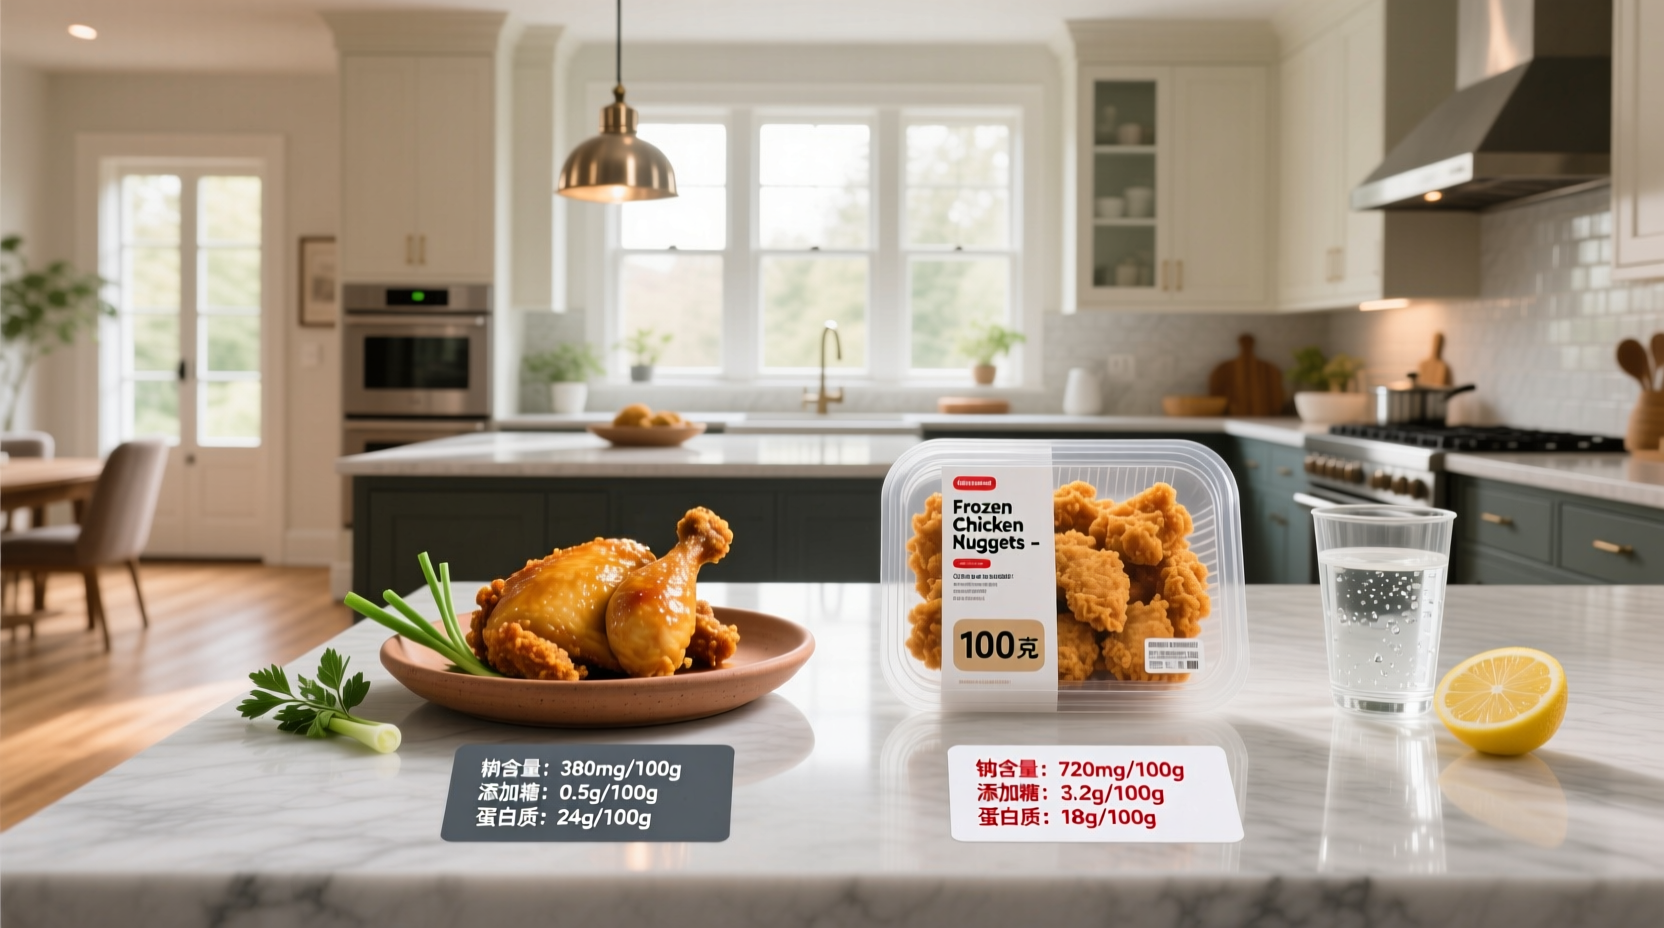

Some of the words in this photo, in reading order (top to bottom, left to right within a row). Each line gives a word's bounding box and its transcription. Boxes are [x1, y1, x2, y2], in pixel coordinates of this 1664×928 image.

[953, 499, 1013, 515] Frozen
[953, 516, 1024, 533] Chicken
[953, 534, 1025, 554] Nuggets
[960, 630, 1039, 660] 100克
[560, 759, 681, 782] 380mg/100g
[1058, 760, 1185, 782] 720mg/100g
[559, 783, 658, 805] 0.5g/100g
[1060, 783, 1165, 805] 3.2g/100g
[556, 807, 652, 830] 24g/100g
[1061, 808, 1157, 830] 18g/100g
